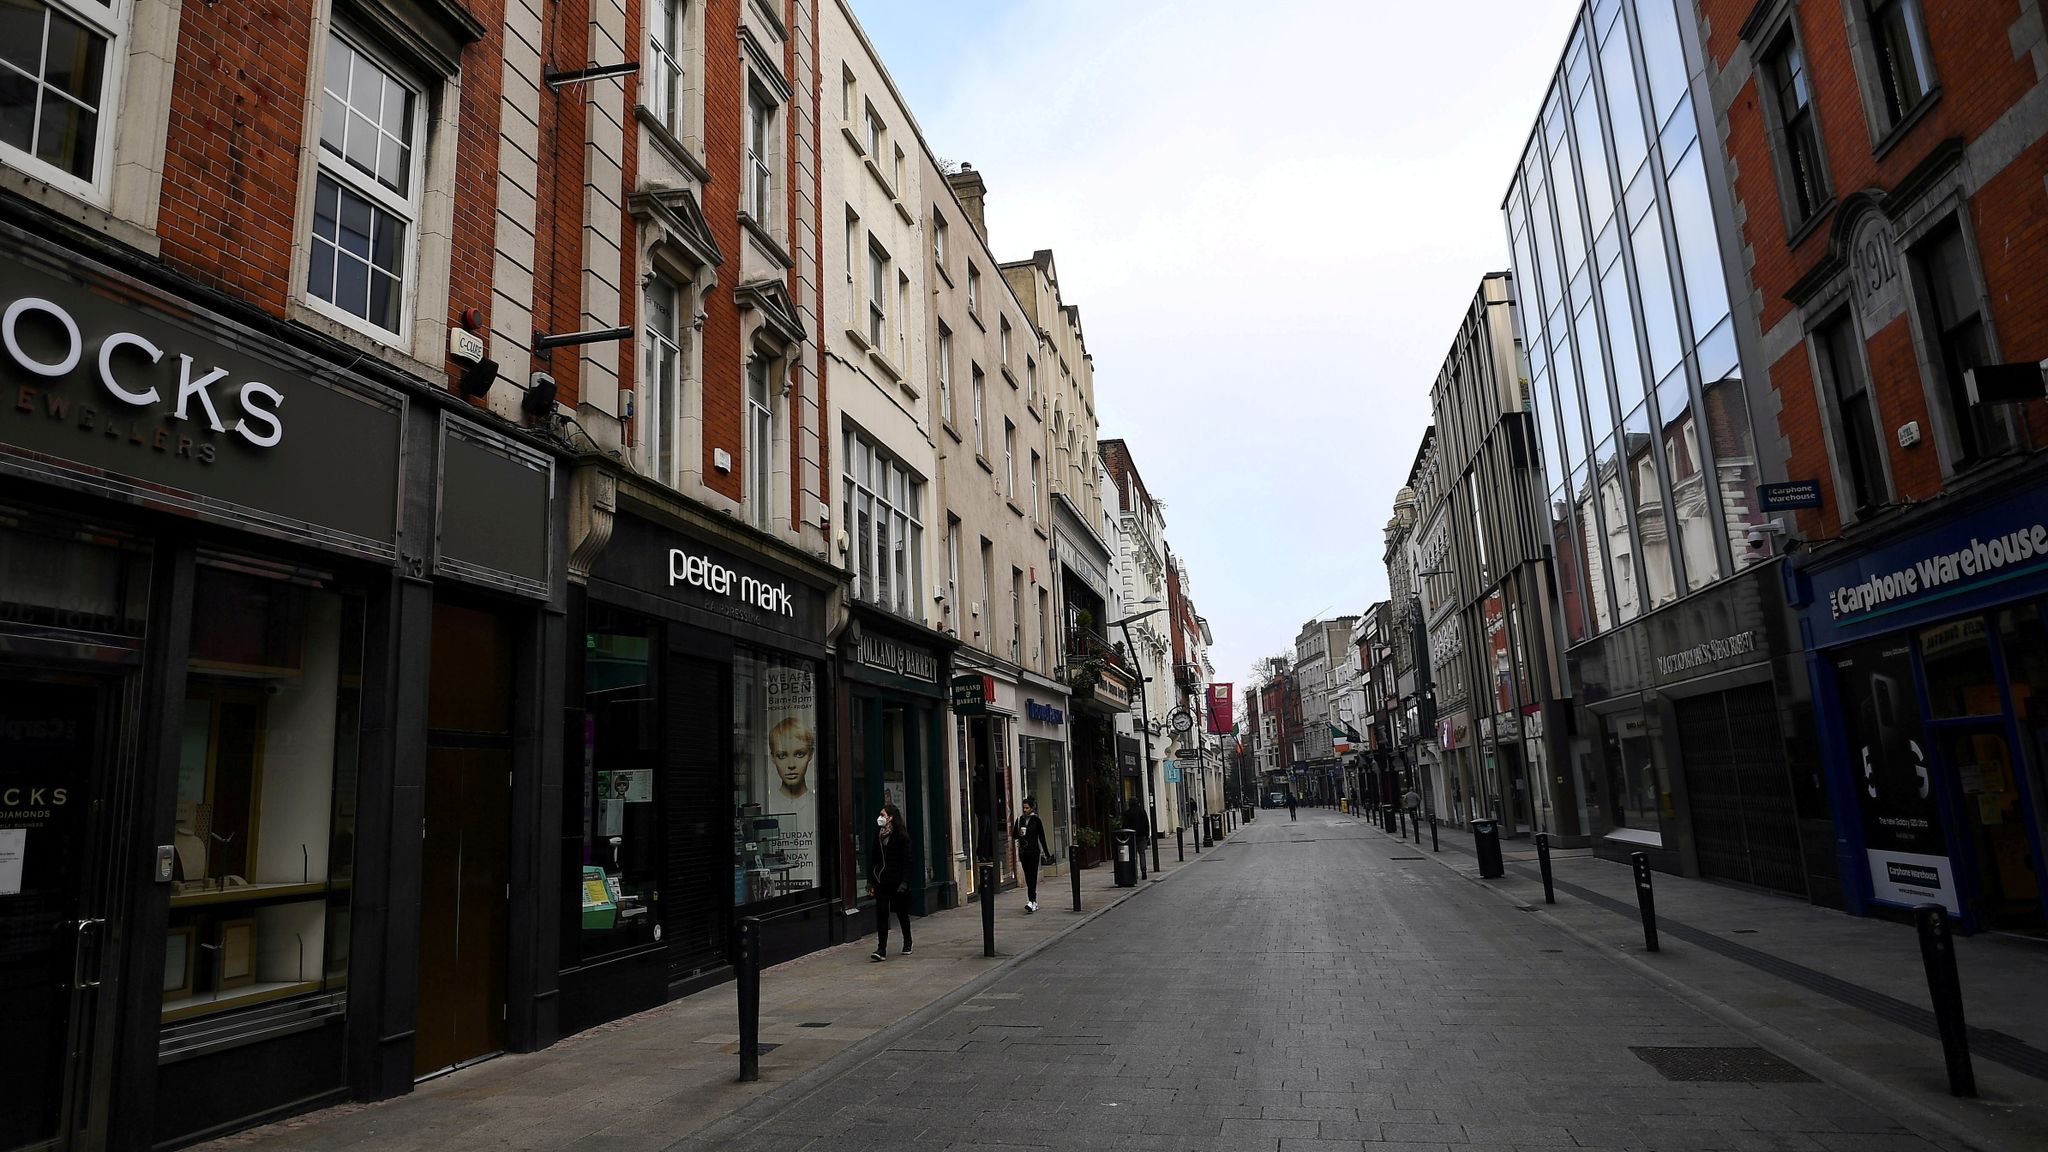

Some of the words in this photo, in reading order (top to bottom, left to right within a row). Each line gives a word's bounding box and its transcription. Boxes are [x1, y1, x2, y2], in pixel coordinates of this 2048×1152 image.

[1772, 485, 1812, 495] Carphone
[1768, 493, 1816, 502] Warehouse
[1838, 567, 1918, 613] Carphone
[1916, 524, 2048, 589] Warehouse
[669, 548, 737, 597] peter
[741, 575, 794, 618] mark
[857, 634, 897, 668] HOLLAND
[905, 650, 938, 684] BARRETT
[768, 673, 786, 683] WE
[789, 672, 811, 681] ARE
[768, 681, 811, 695] OPEN
[955, 684, 981, 693] HOLLAND
[956, 697, 980, 706] BARRETT
[781, 831, 813, 839] TURDAY
